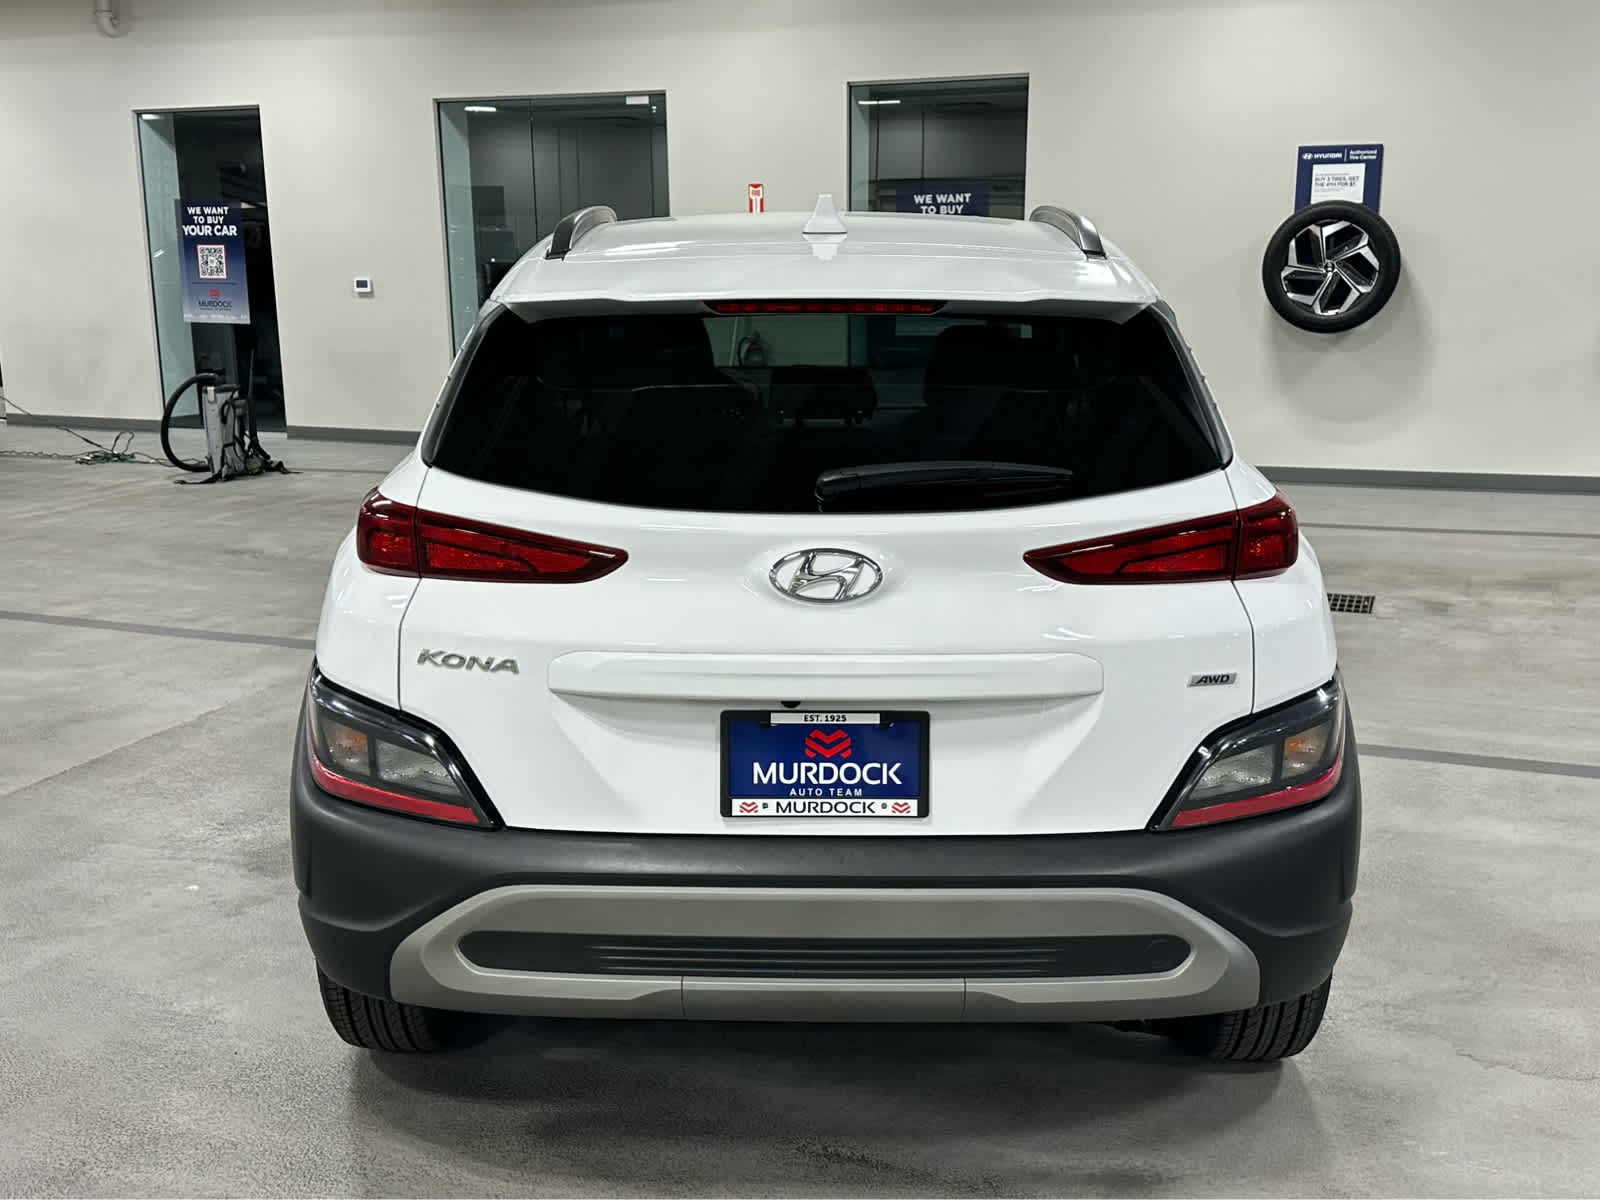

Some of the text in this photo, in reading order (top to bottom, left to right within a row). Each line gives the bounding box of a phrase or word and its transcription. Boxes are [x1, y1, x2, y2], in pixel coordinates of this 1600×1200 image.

[914, 193, 972, 204] WE WANT
[187, 206, 229, 215] WE WANT
[921, 205, 964, 214] TO BUY
[193, 216, 224, 224] TO BUY
[182, 225, 237, 236] YOUR CAR
[198, 300, 232, 308] MURDOCK
[417, 648, 519, 675] KONA
[1195, 674, 1230, 684] AWD
[803, 714, 847, 723] EST. 1925
[753, 762, 902, 784] MURDOCK
[790, 788, 863, 796] AUTO TEAM
[776, 801, 876, 814] MURDOCK
